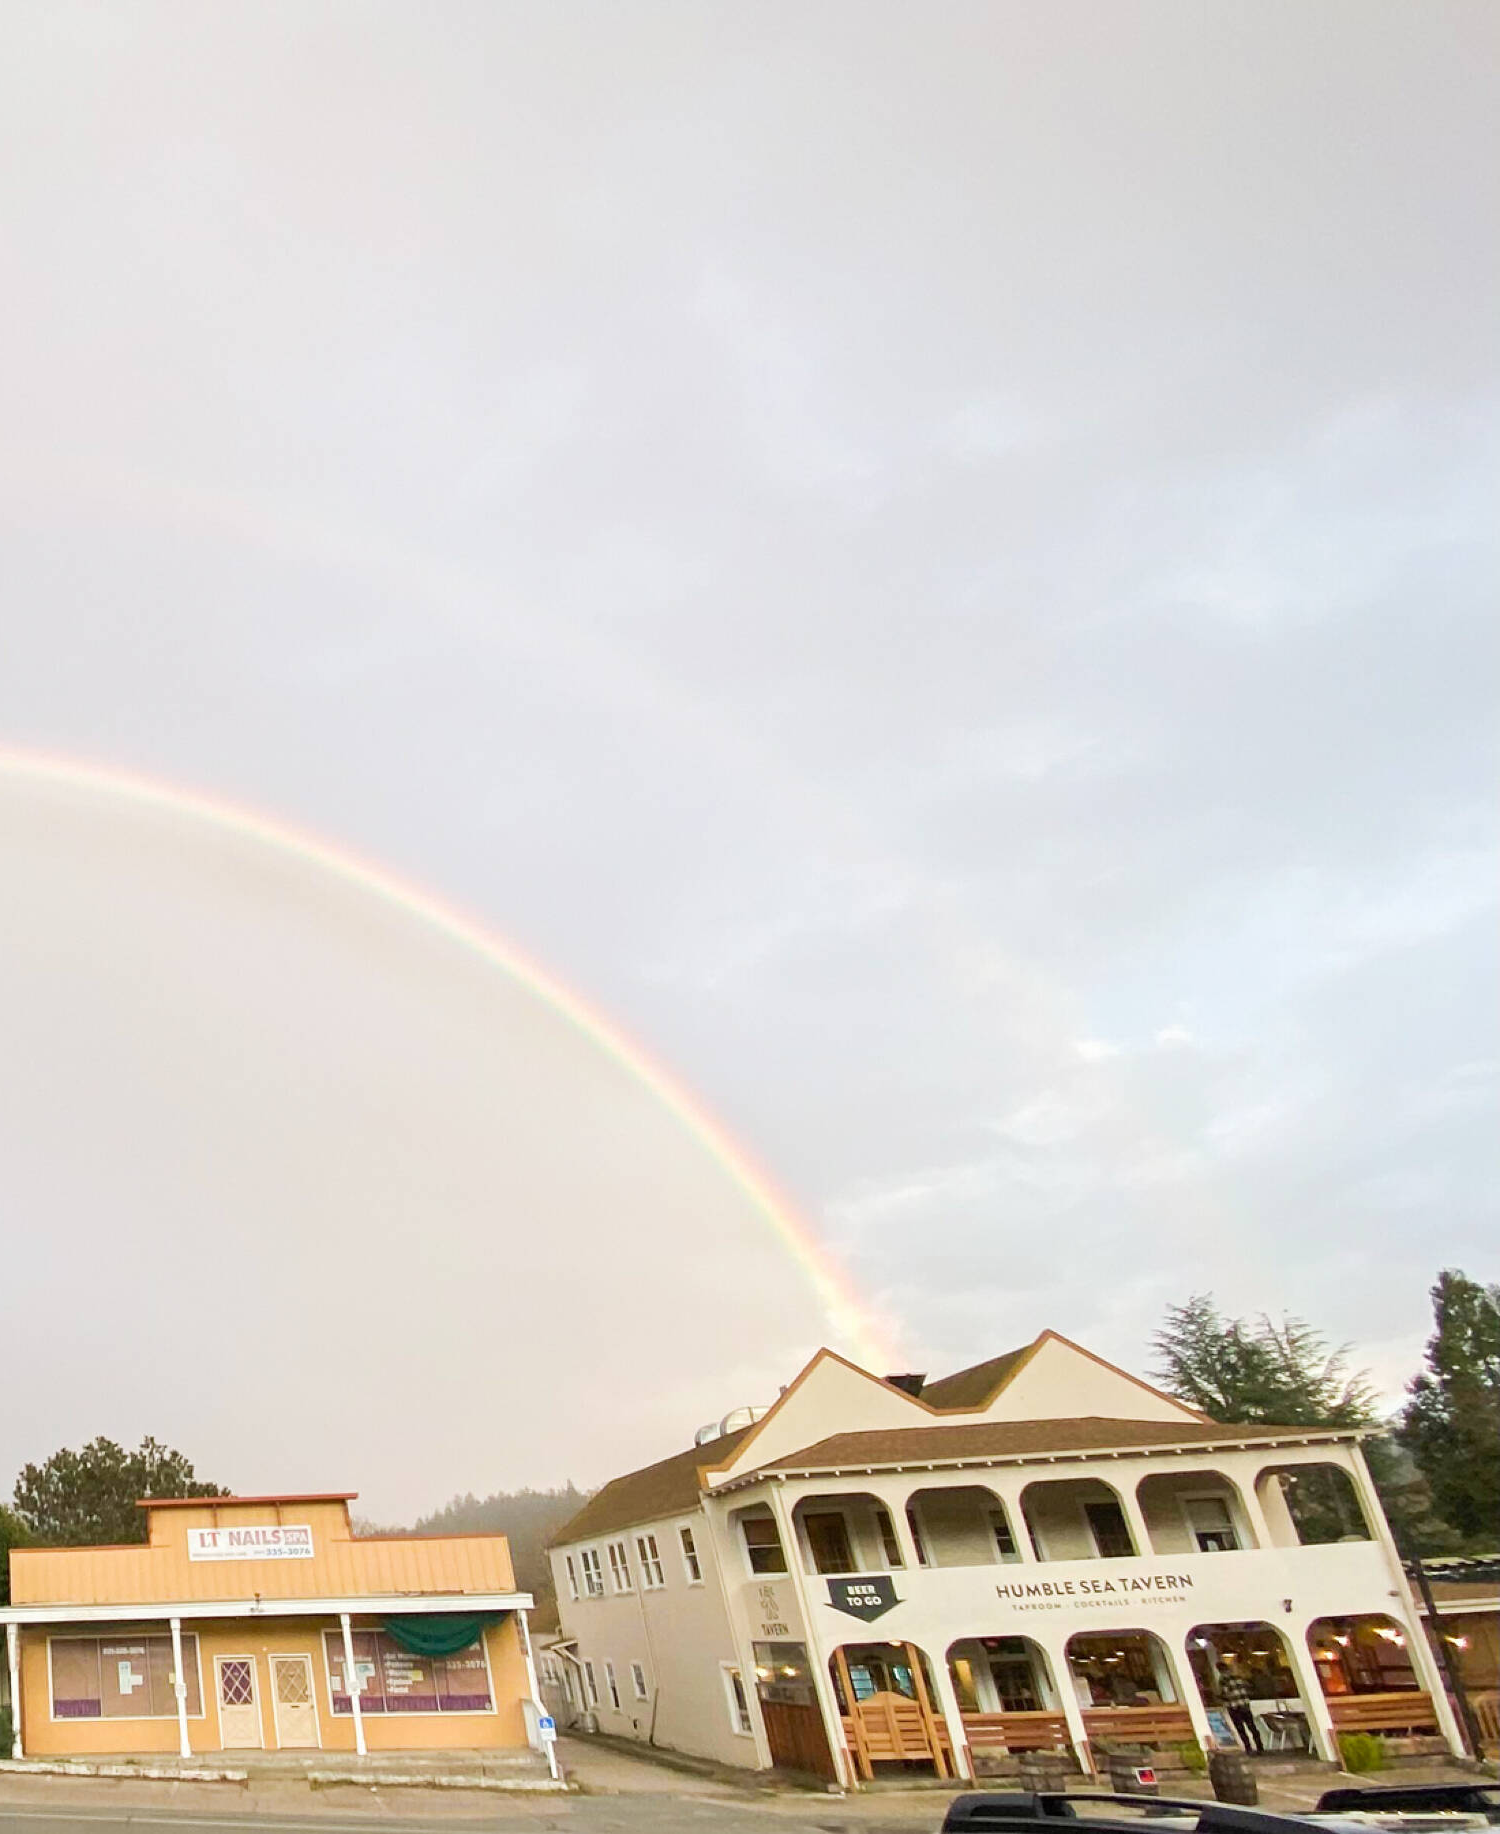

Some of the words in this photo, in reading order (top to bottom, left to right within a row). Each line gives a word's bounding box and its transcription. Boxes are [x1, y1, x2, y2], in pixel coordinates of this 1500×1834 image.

[229, 1529, 281, 1546] NAILS
[846, 1584, 876, 1595] BEER
[996, 1582, 1076, 1598] HUMBLE
[1079, 1578, 1116, 1594] SEA
[1118, 1574, 1194, 1592] TAVERN
[846, 1597, 863, 1606] TO
[864, 1596, 882, 1606] GO
[1012, 1602, 1062, 1611] TAPROOM
[1074, 1598, 1129, 1609] COCKTAILS
[1141, 1595, 1187, 1605] KITCHEN
